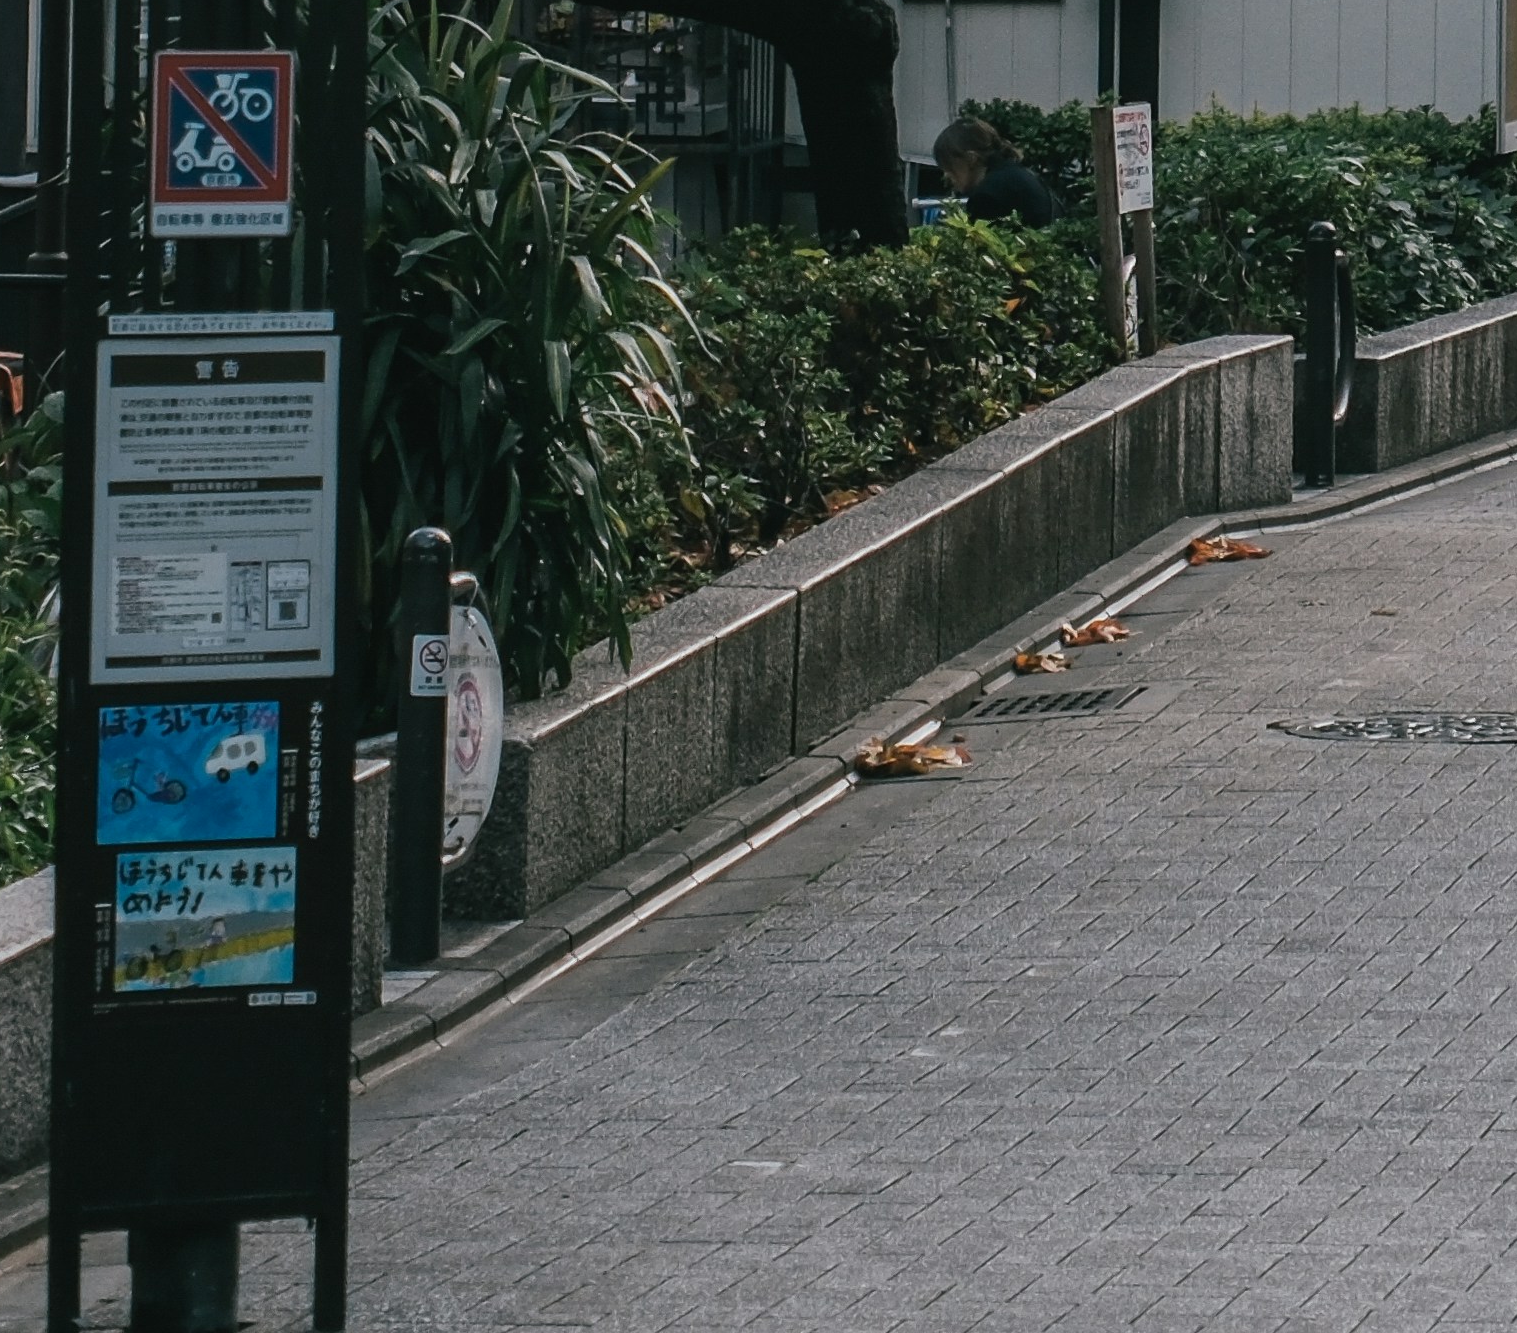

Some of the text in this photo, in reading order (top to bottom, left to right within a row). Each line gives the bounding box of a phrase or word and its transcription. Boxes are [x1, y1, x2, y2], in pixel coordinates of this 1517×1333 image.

[307, 700, 324, 838] みんなこのまちが好き
